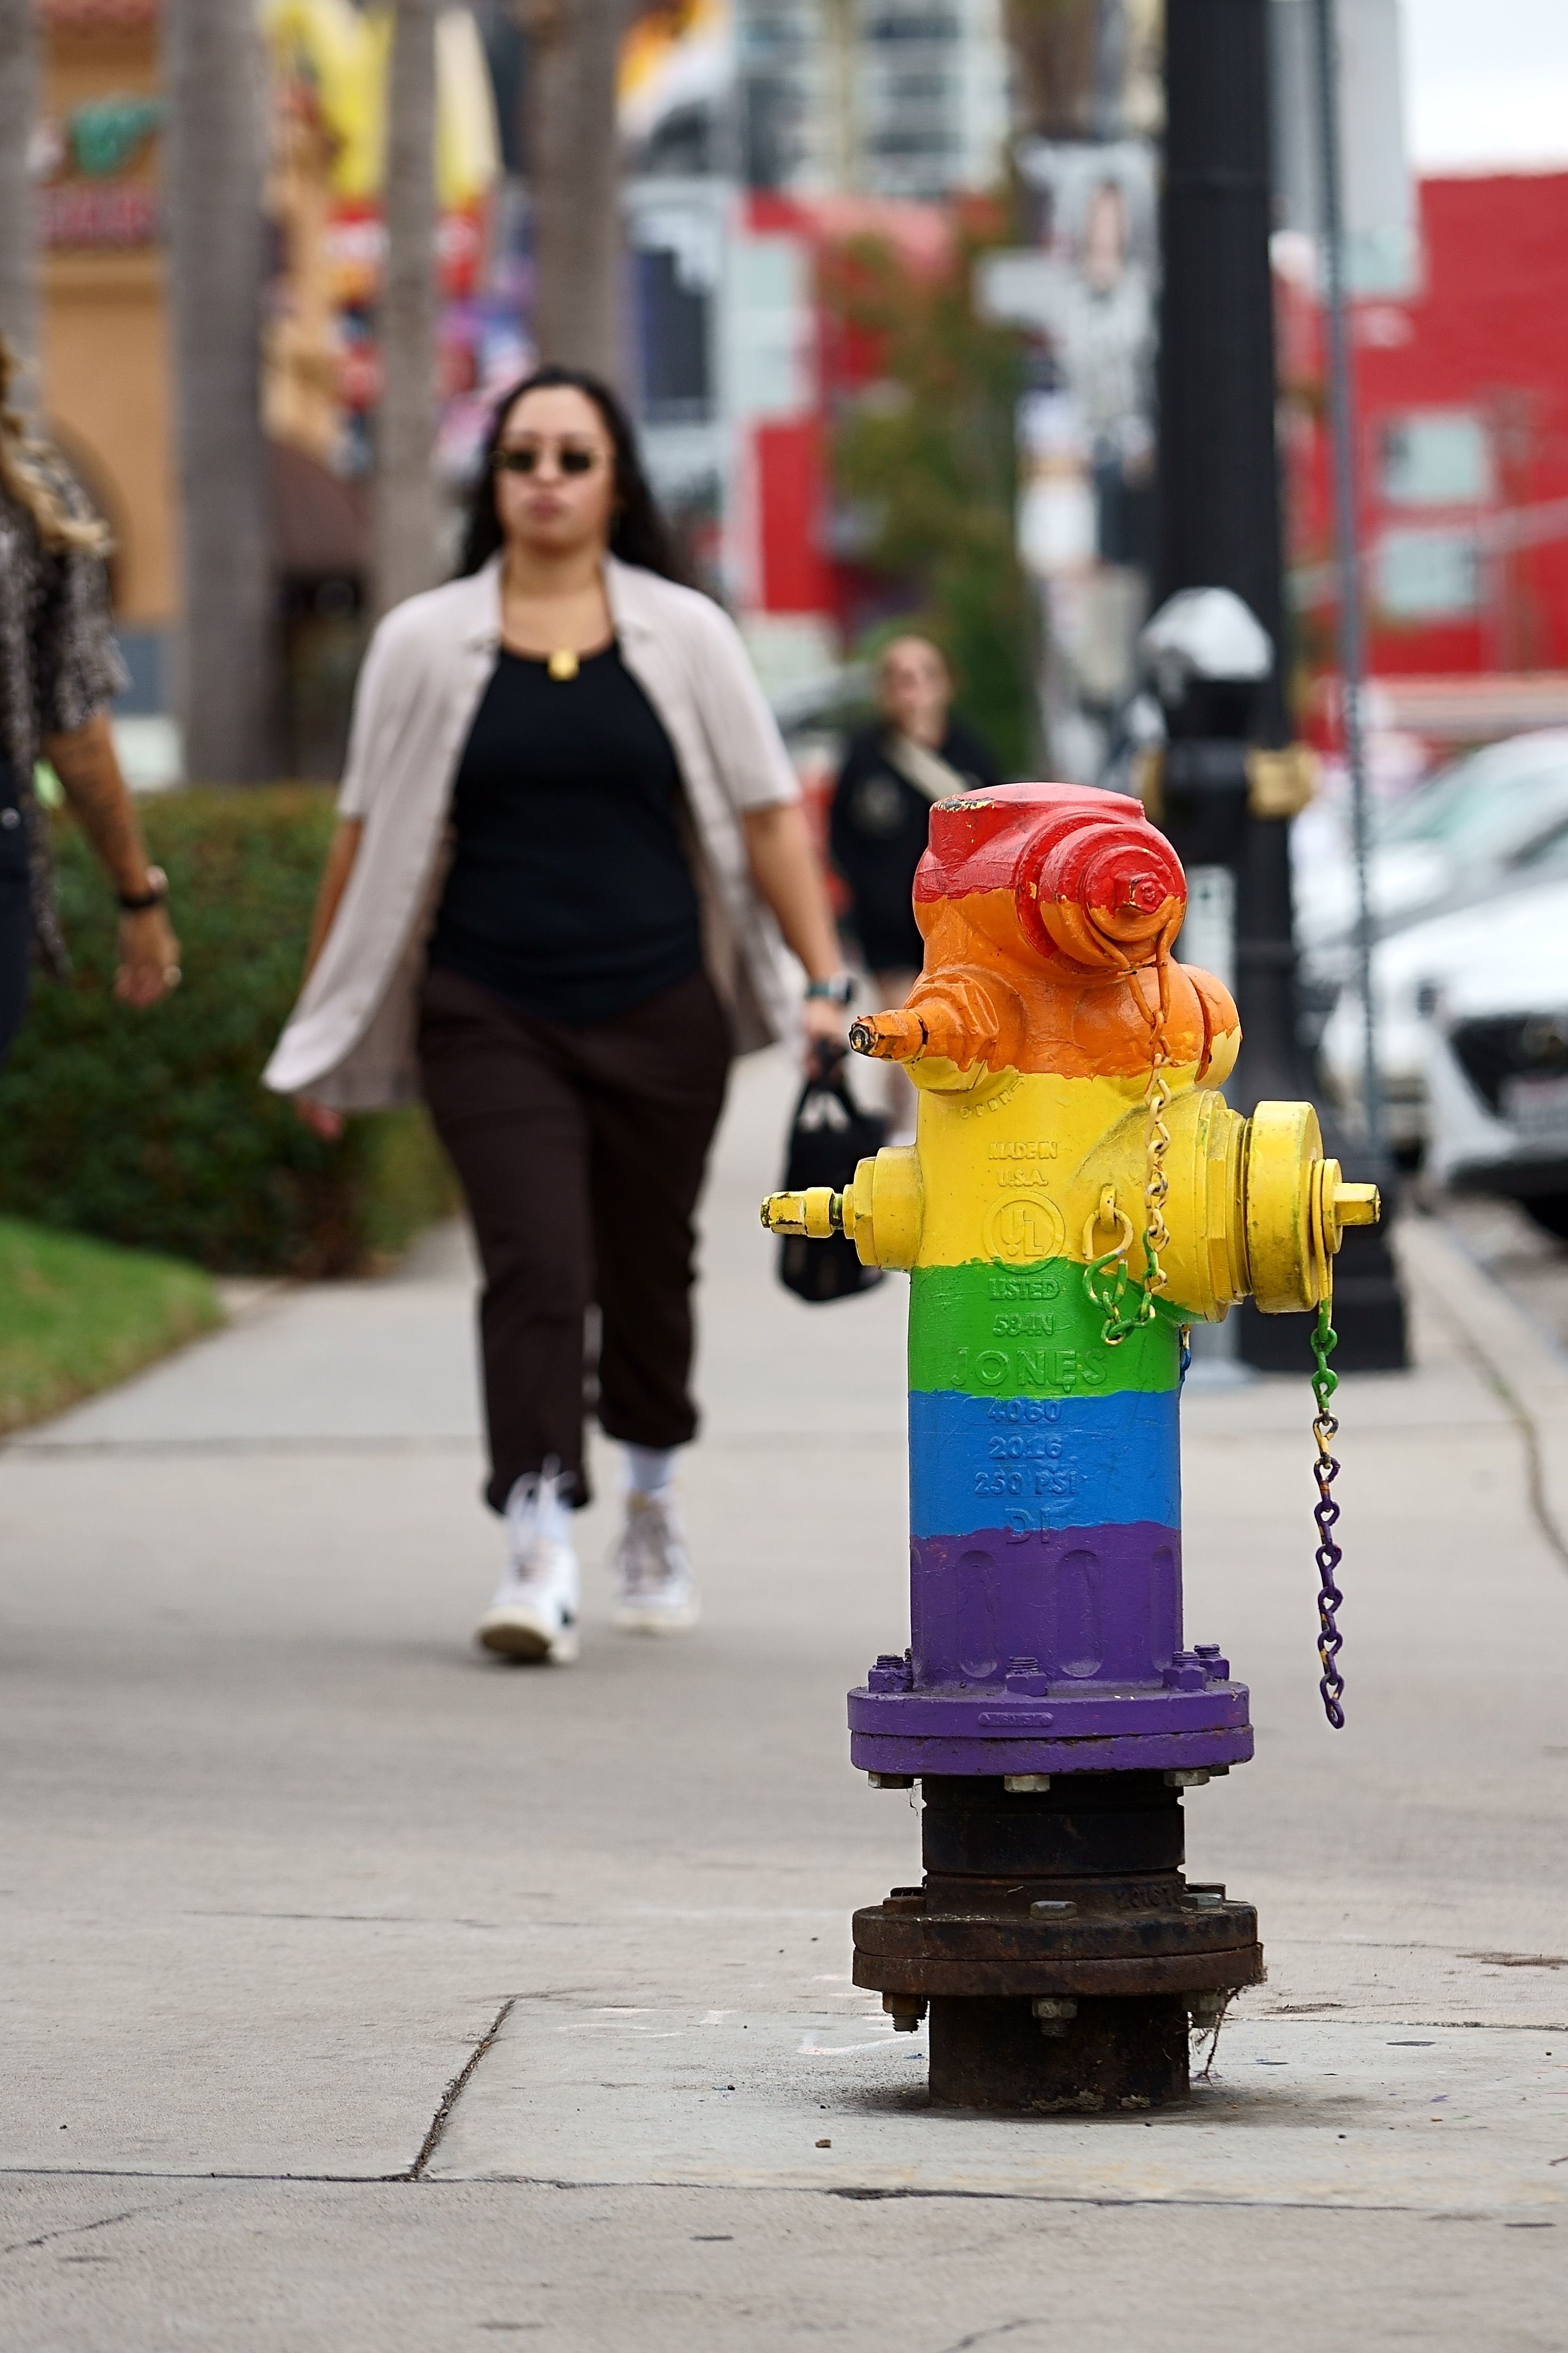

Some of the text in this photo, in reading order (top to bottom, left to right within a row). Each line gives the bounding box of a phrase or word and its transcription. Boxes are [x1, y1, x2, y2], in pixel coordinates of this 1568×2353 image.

[988, 1141, 1058, 1160] MADE IN
[988, 1277, 1060, 1300] LISTED
[949, 1347, 1108, 1387] JONES
[987, 1399, 1062, 1422] 4060
[989, 1435, 1063, 1459] 2016
[974, 1470, 1078, 1495] 250 PSI
[1005, 1507, 1052, 1544] DI
